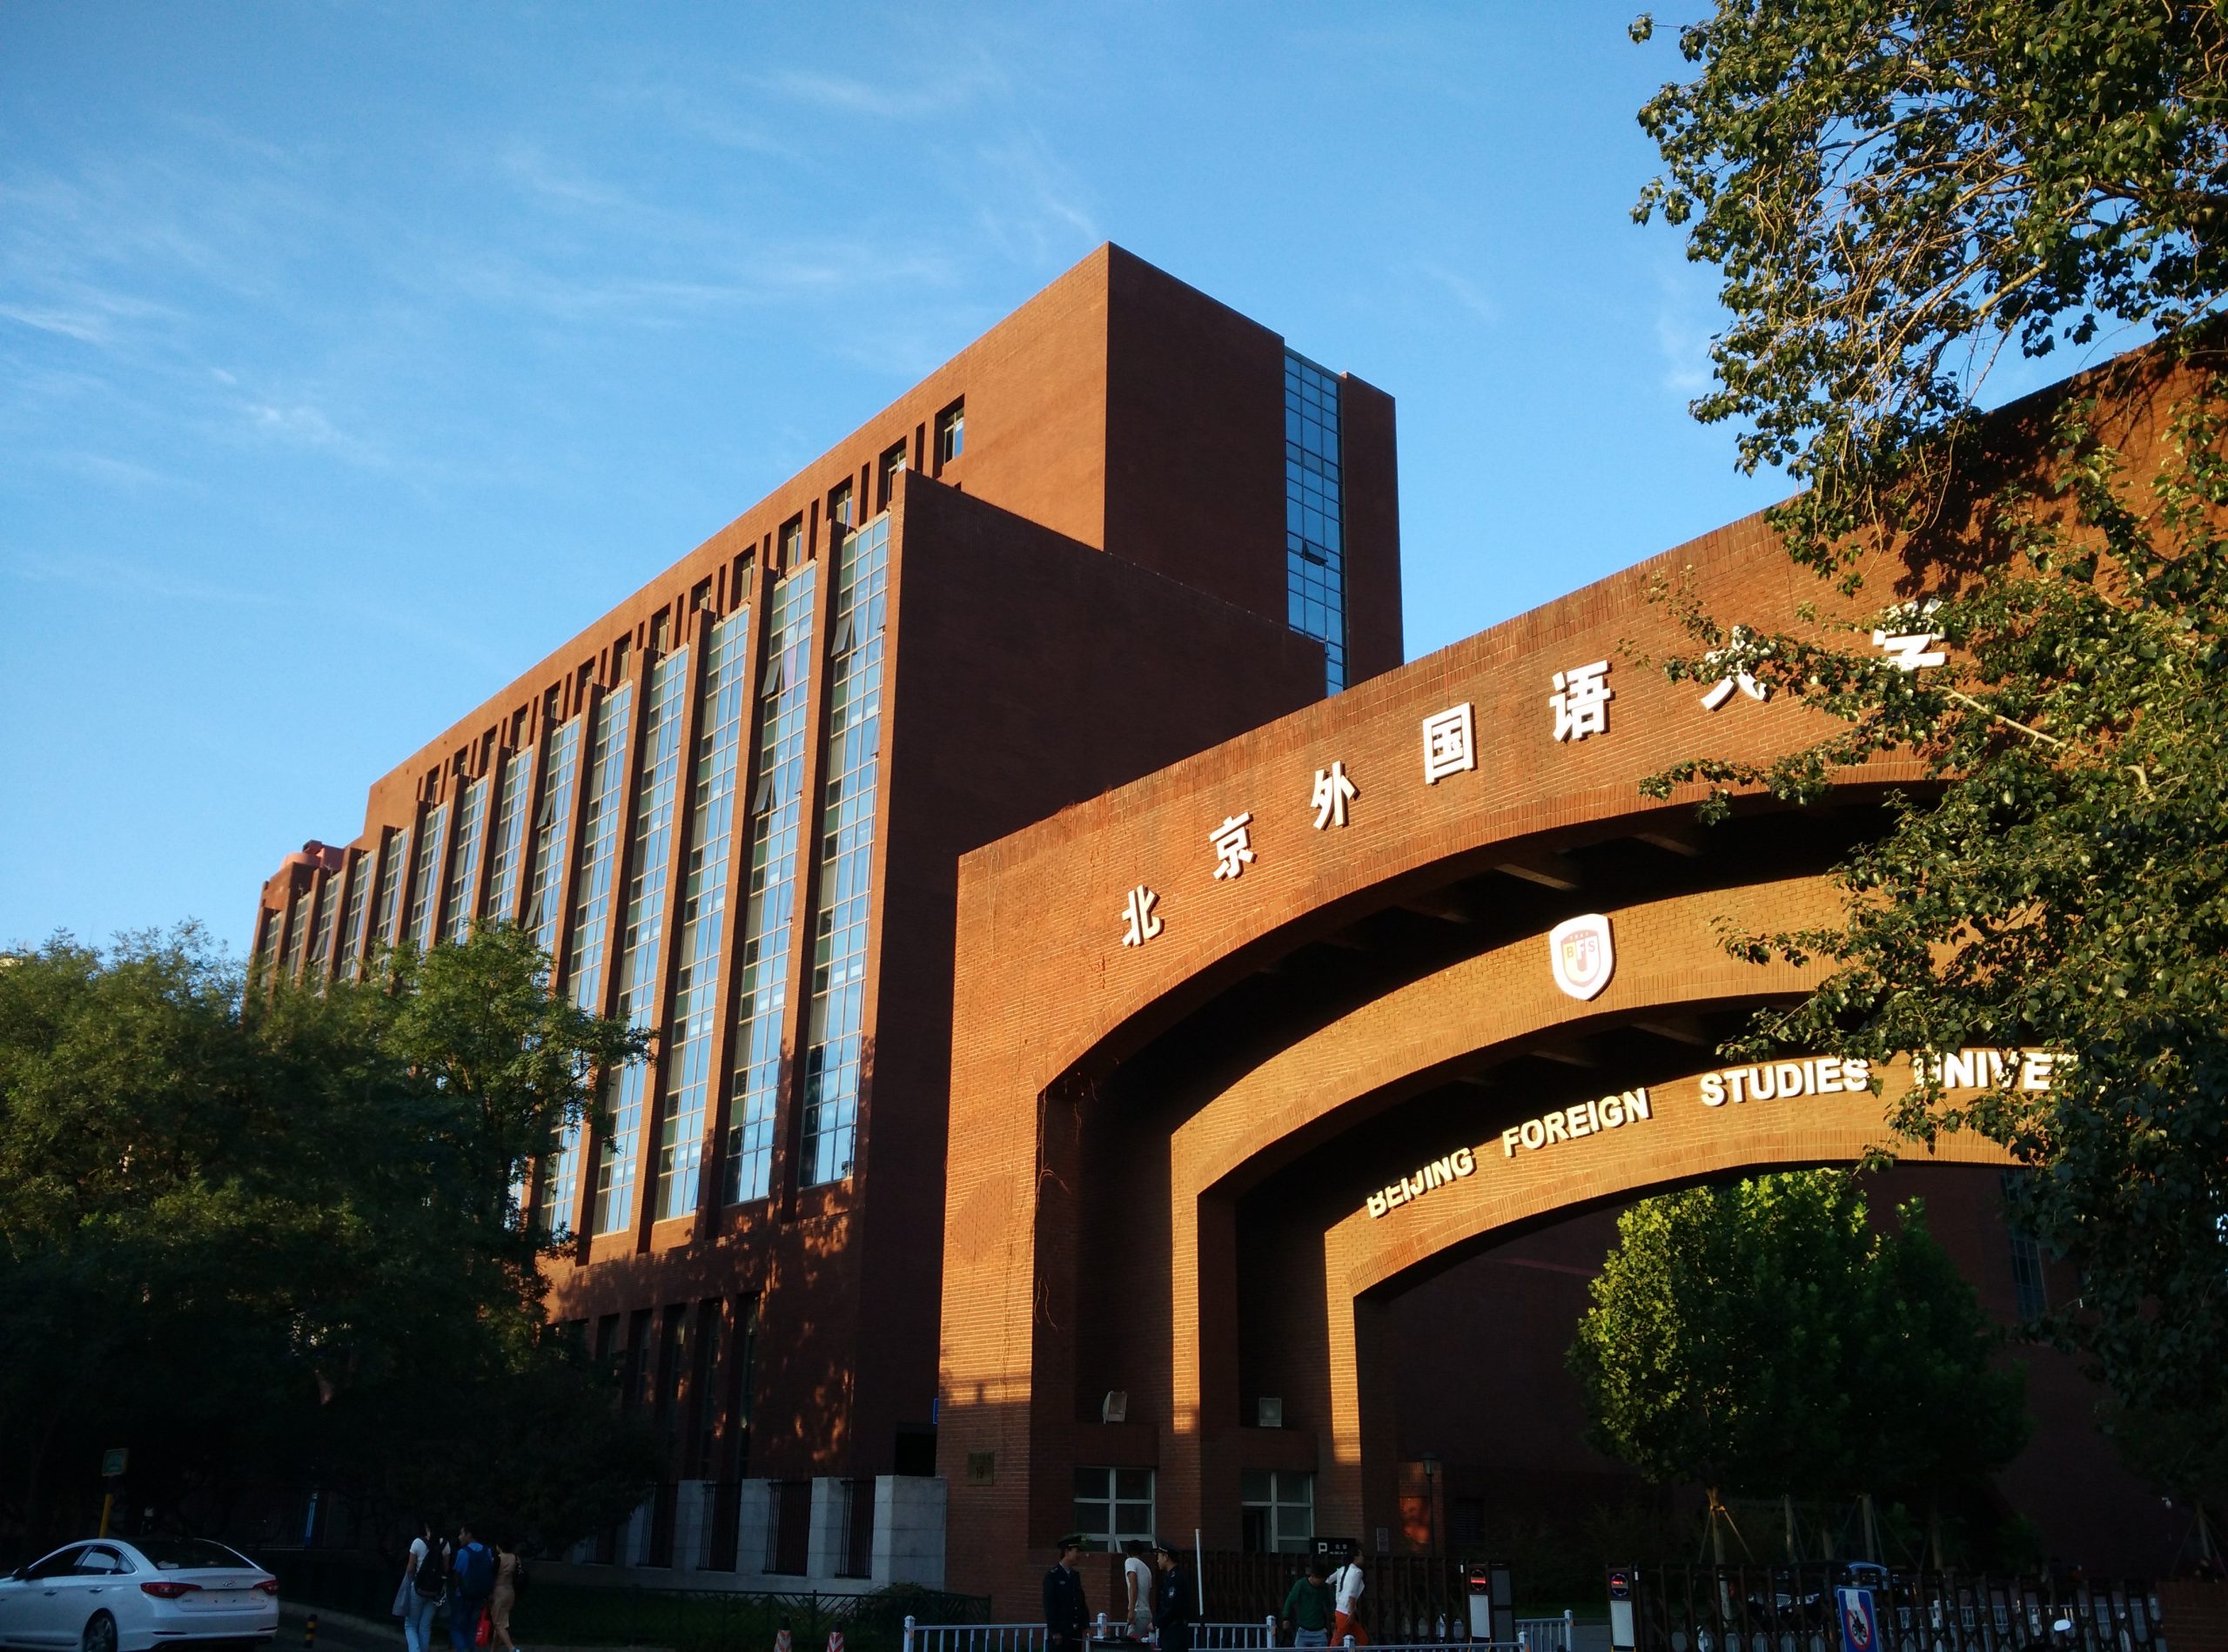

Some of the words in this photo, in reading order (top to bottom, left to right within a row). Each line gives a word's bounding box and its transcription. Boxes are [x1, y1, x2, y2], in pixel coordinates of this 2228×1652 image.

[1366, 1147, 1474, 1219] BEIJING
[1502, 1087, 1650, 1157] FOREIGN
[1700, 1057, 1869, 1106] STUDIES
